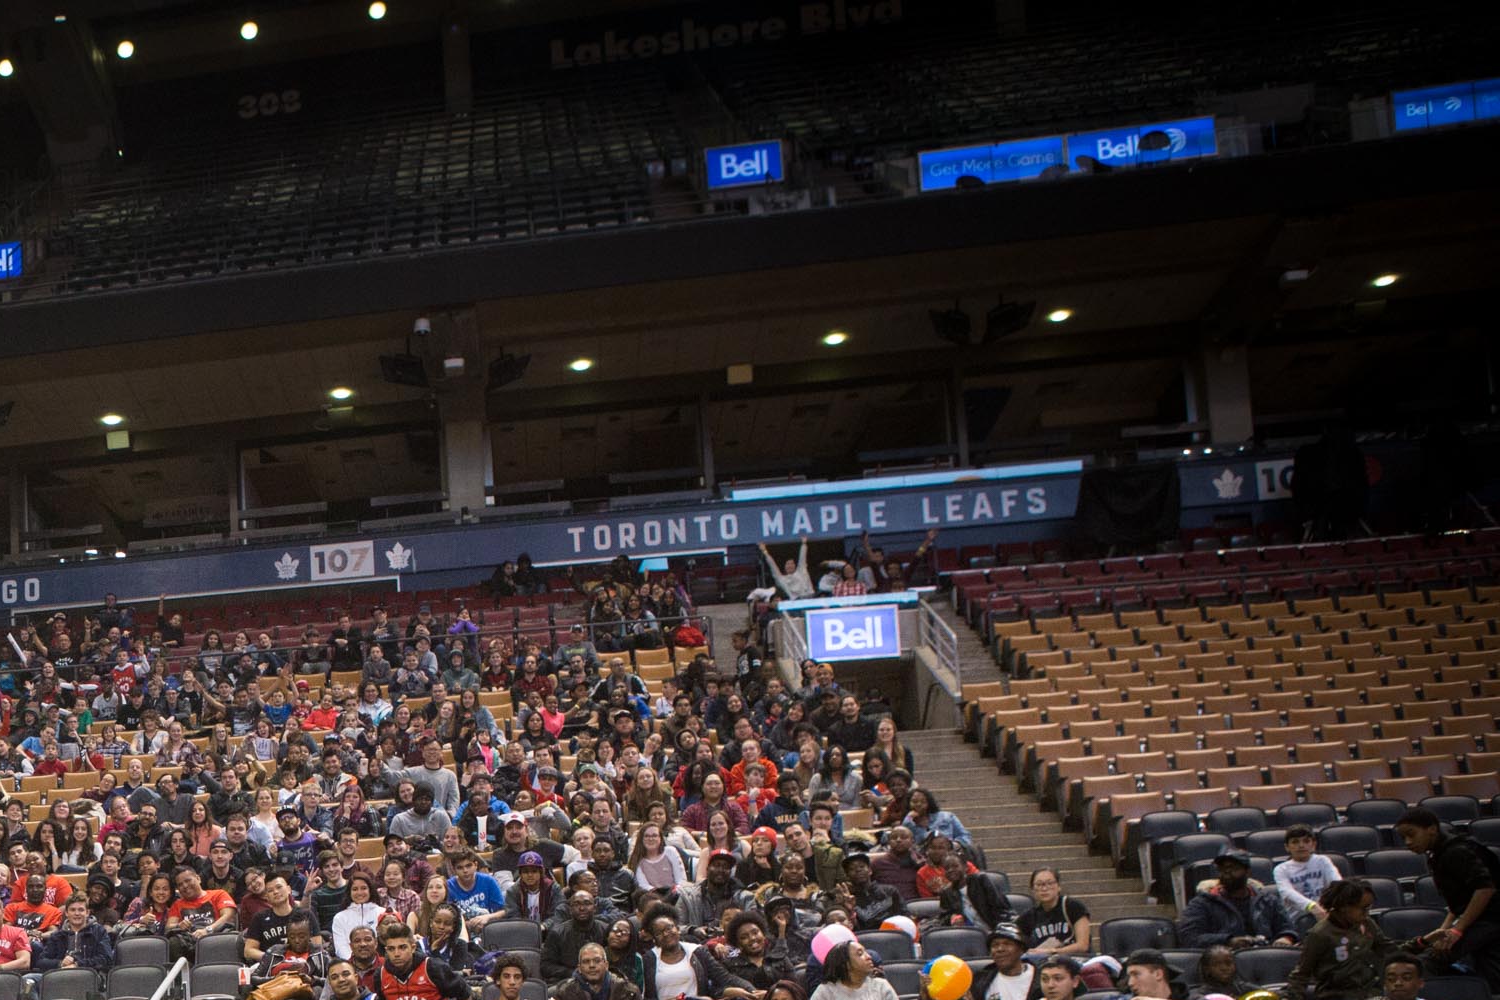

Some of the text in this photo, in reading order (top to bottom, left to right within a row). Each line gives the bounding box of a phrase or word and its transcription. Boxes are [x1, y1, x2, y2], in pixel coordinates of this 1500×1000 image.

[549, 0, 903, 68] Lakeshore Blvd
[236, 88, 302, 119] 308
[1097, 133, 1139, 161] Bell
[720, 149, 769, 180] Bell
[930, 152, 1054, 178] Get More Game
[1262, 466, 1296, 493] 10
[568, 485, 1048, 554] TORONTO MAPLE LEAFS
[314, 547, 369, 575] 107
[1, 577, 41, 604] GO
[823, 616, 883, 651] Bell
[263, 925, 288, 940] RAPT
[1034, 922, 1069, 939] ORONTO
